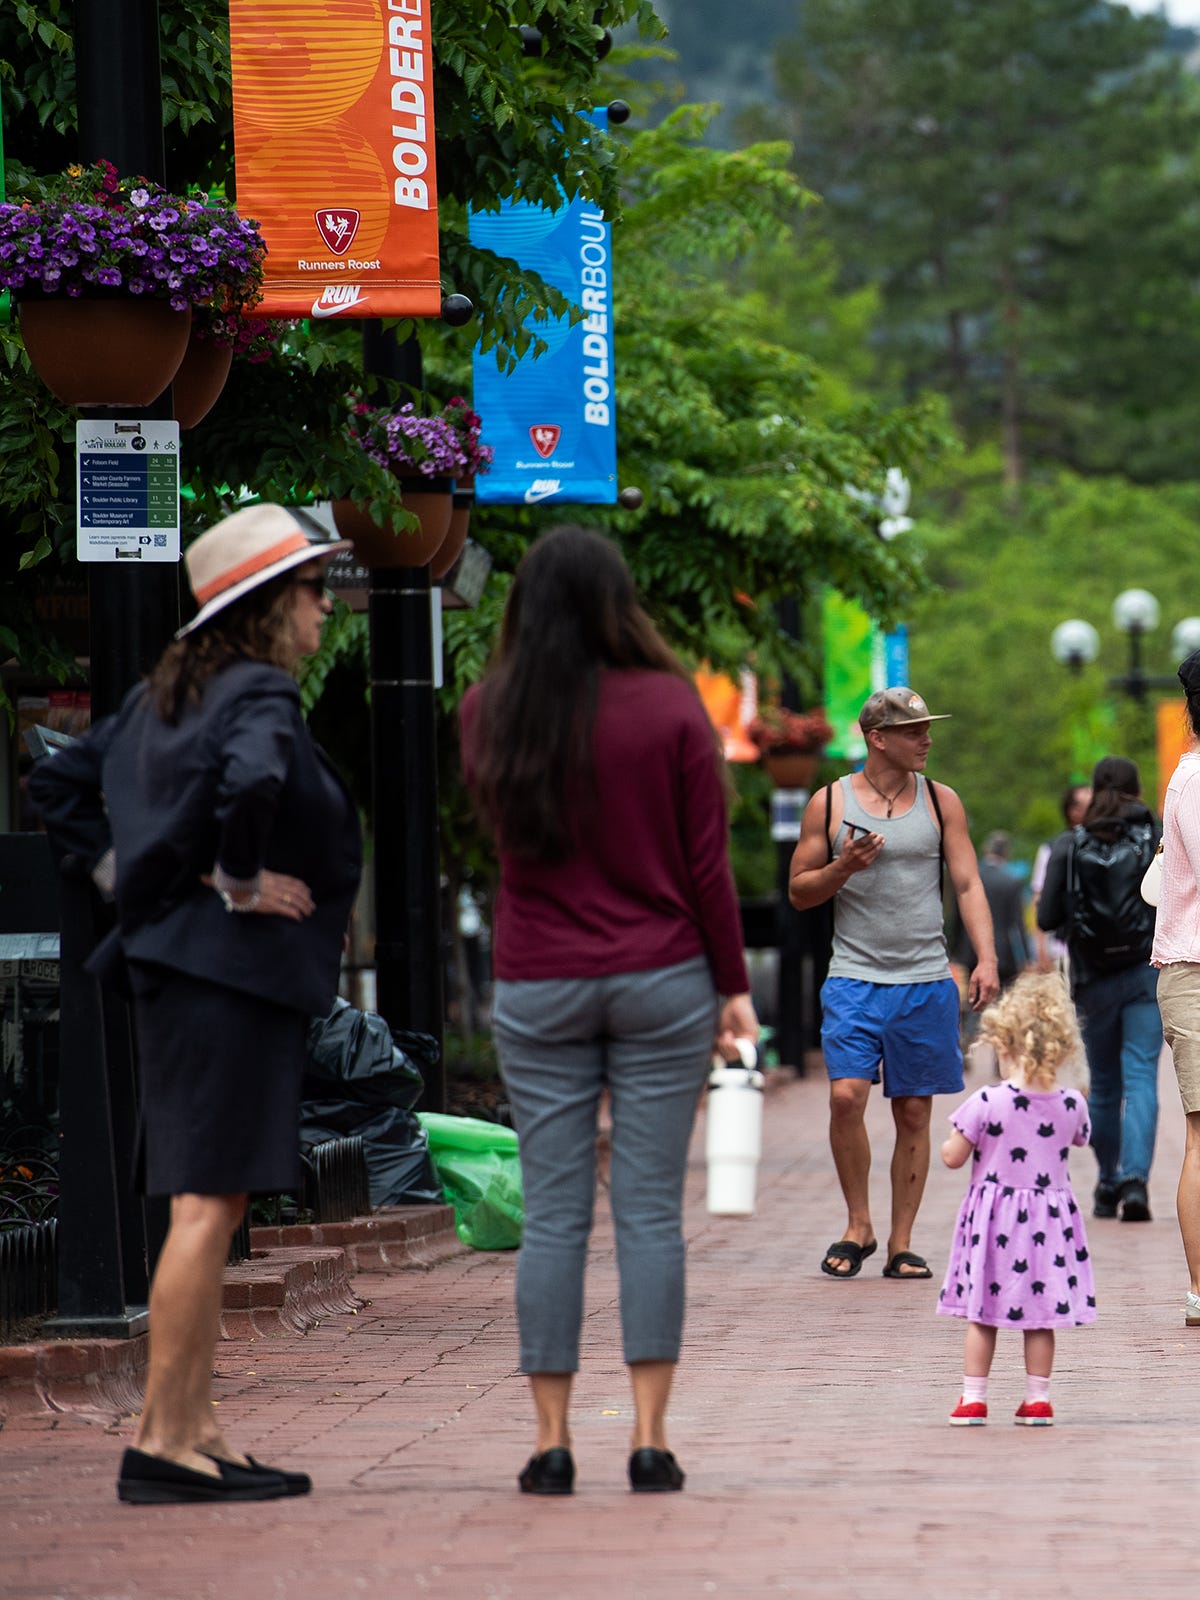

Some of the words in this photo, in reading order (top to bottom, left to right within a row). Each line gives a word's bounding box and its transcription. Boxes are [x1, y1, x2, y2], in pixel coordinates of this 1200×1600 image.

[298, 260, 345, 270] Runners
[348, 259, 380, 270] Roost
[321, 285, 361, 303] RUN
[579, 209, 610, 426] BOLDERBOUL
